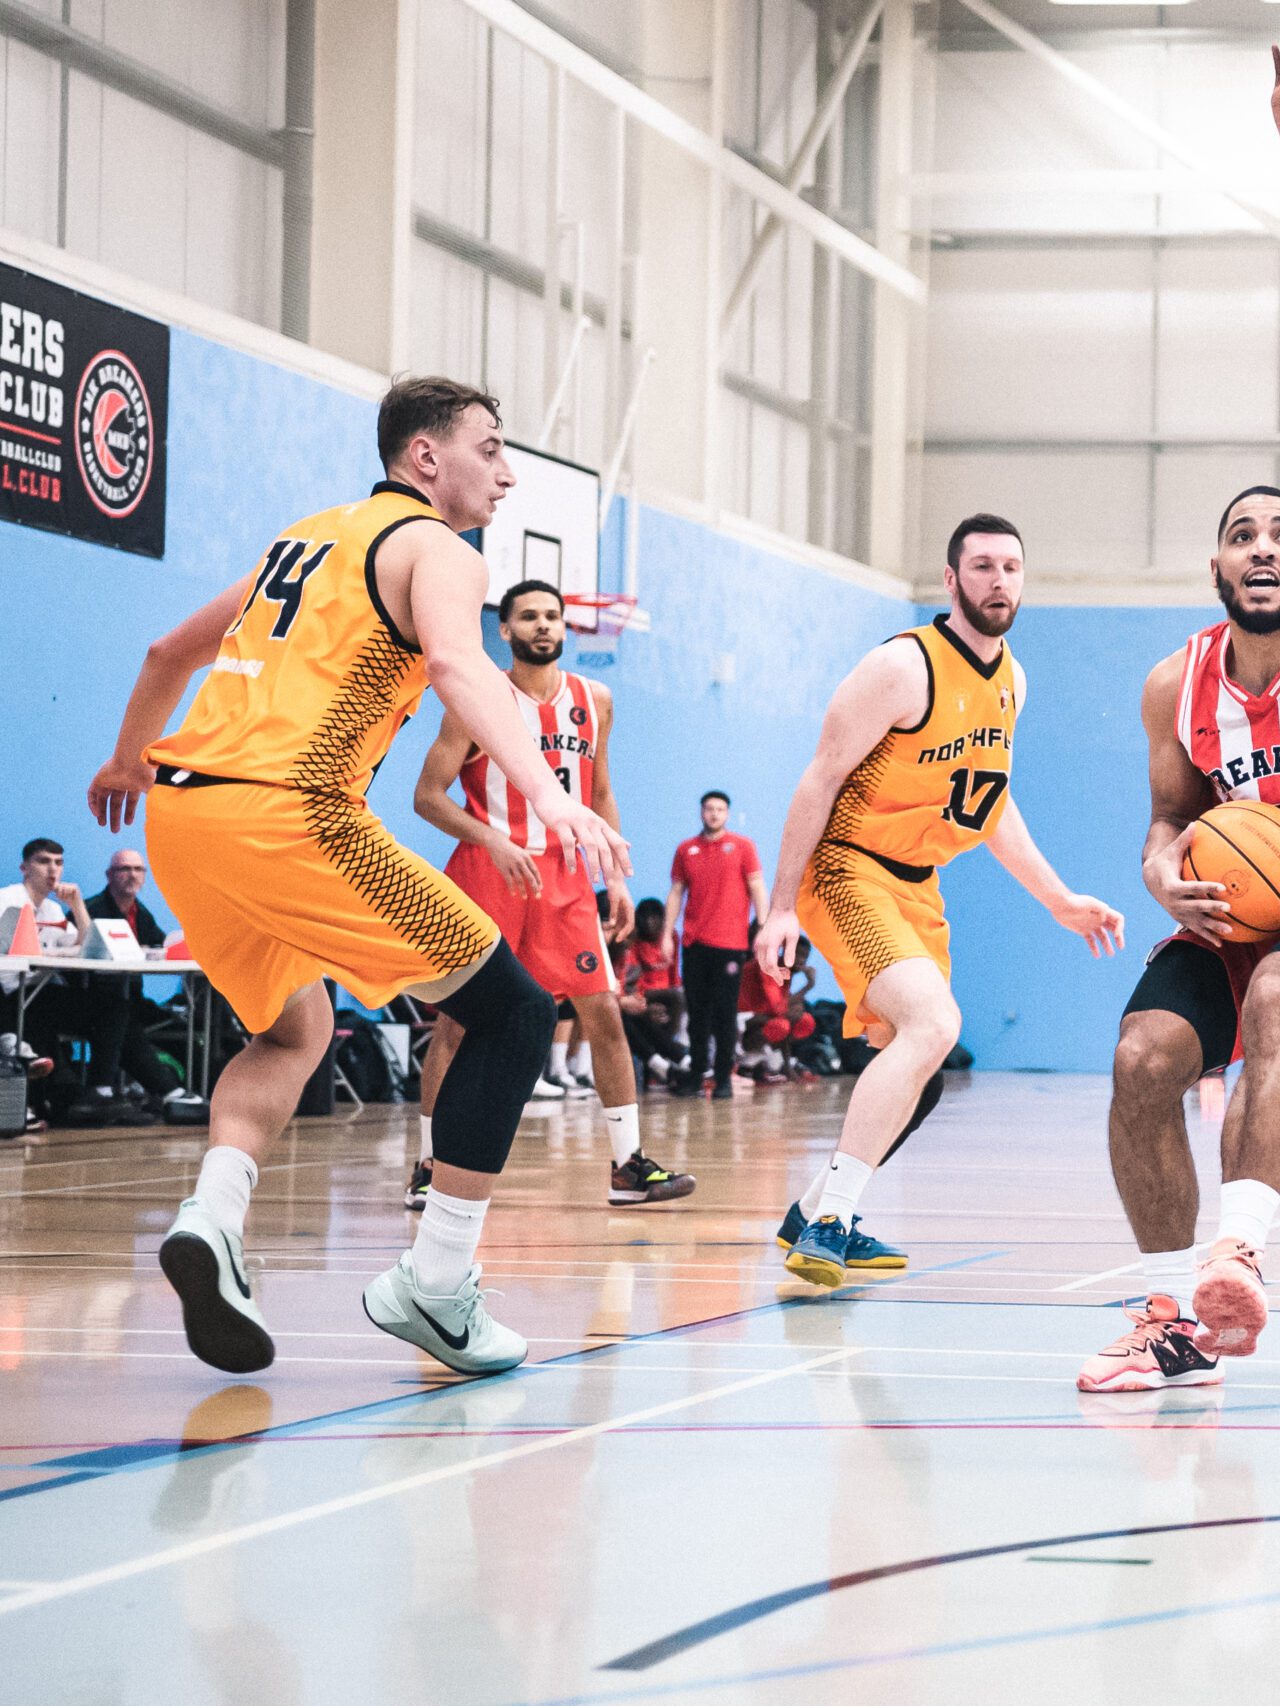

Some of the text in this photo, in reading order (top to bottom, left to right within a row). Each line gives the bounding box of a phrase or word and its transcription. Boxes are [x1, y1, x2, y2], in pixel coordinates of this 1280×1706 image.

[0, 371, 64, 428] CLUB
[98, 364, 147, 429] BREAKERS
[225, 537, 338, 640] 14
